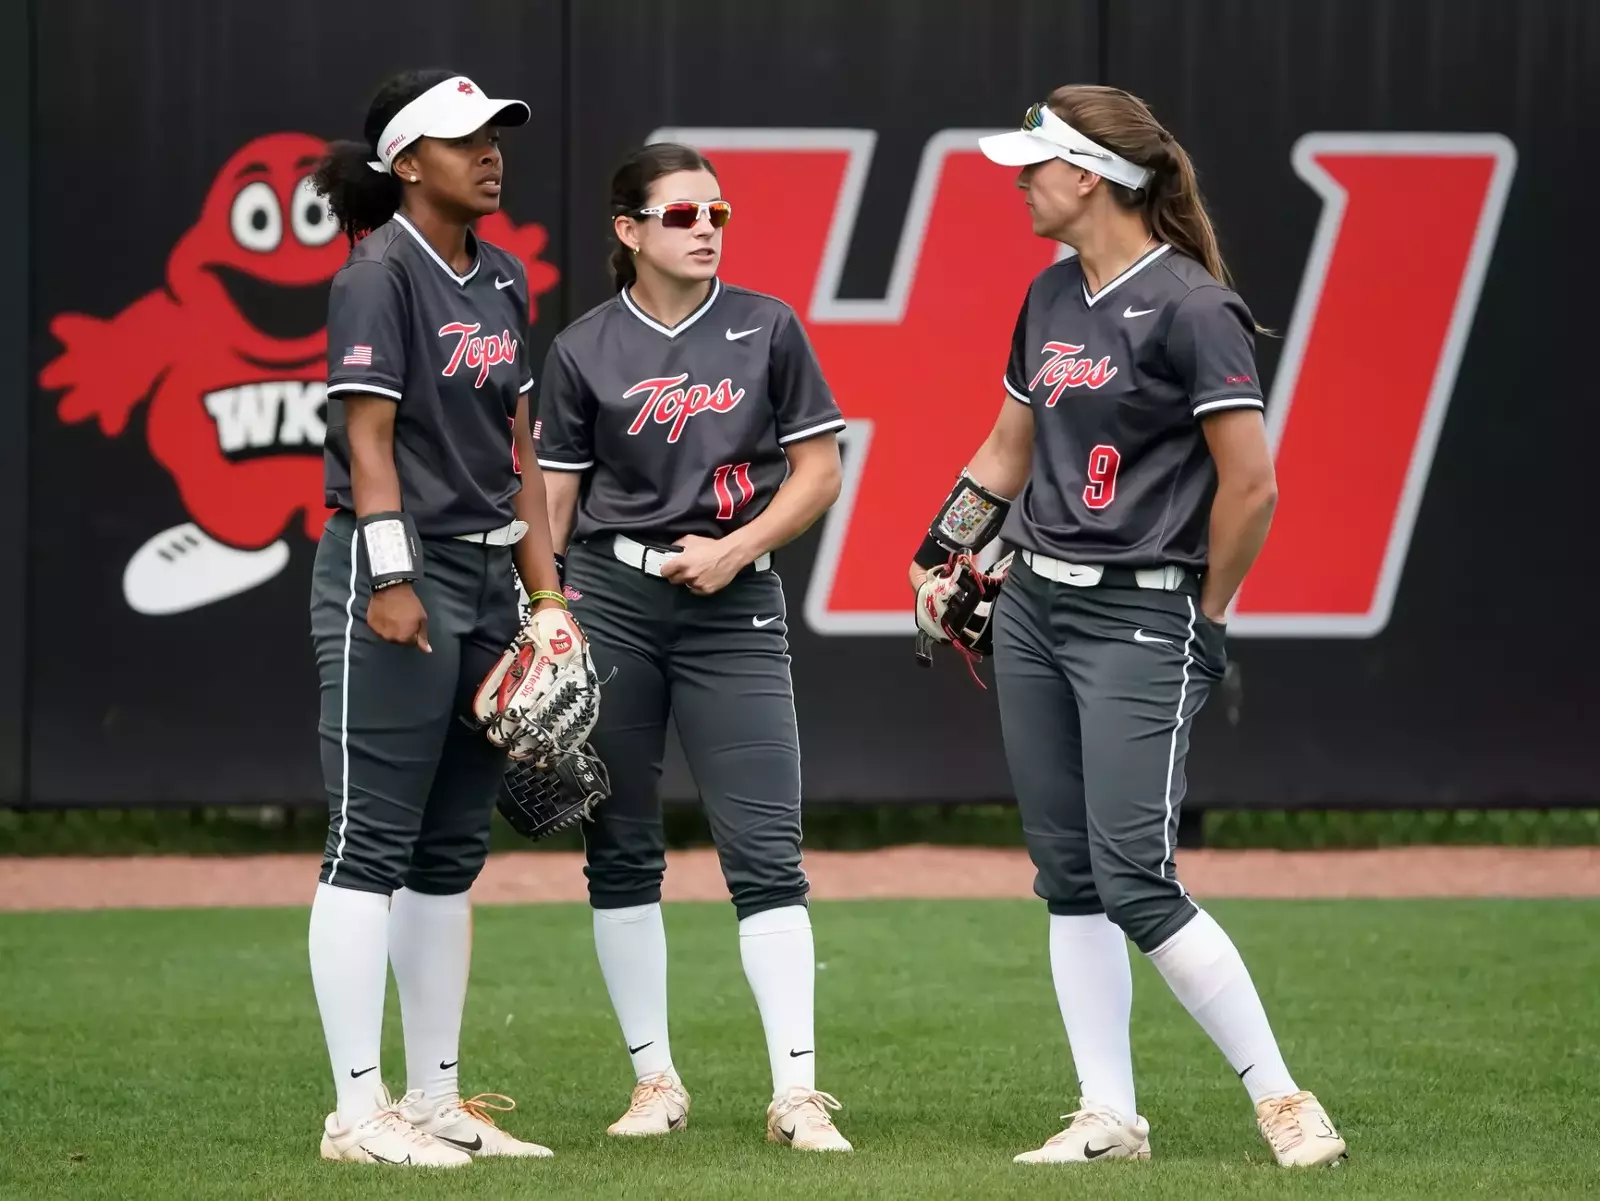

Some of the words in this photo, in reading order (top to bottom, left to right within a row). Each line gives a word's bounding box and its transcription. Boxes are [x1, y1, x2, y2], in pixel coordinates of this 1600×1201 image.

[438, 321, 517, 389] Tops
[1028, 341, 1118, 408] Tops
[202, 380, 328, 453] WK
[622, 373, 746, 444] Tops
[713, 462, 755, 519] 11
[1082, 444, 1121, 509] 9
